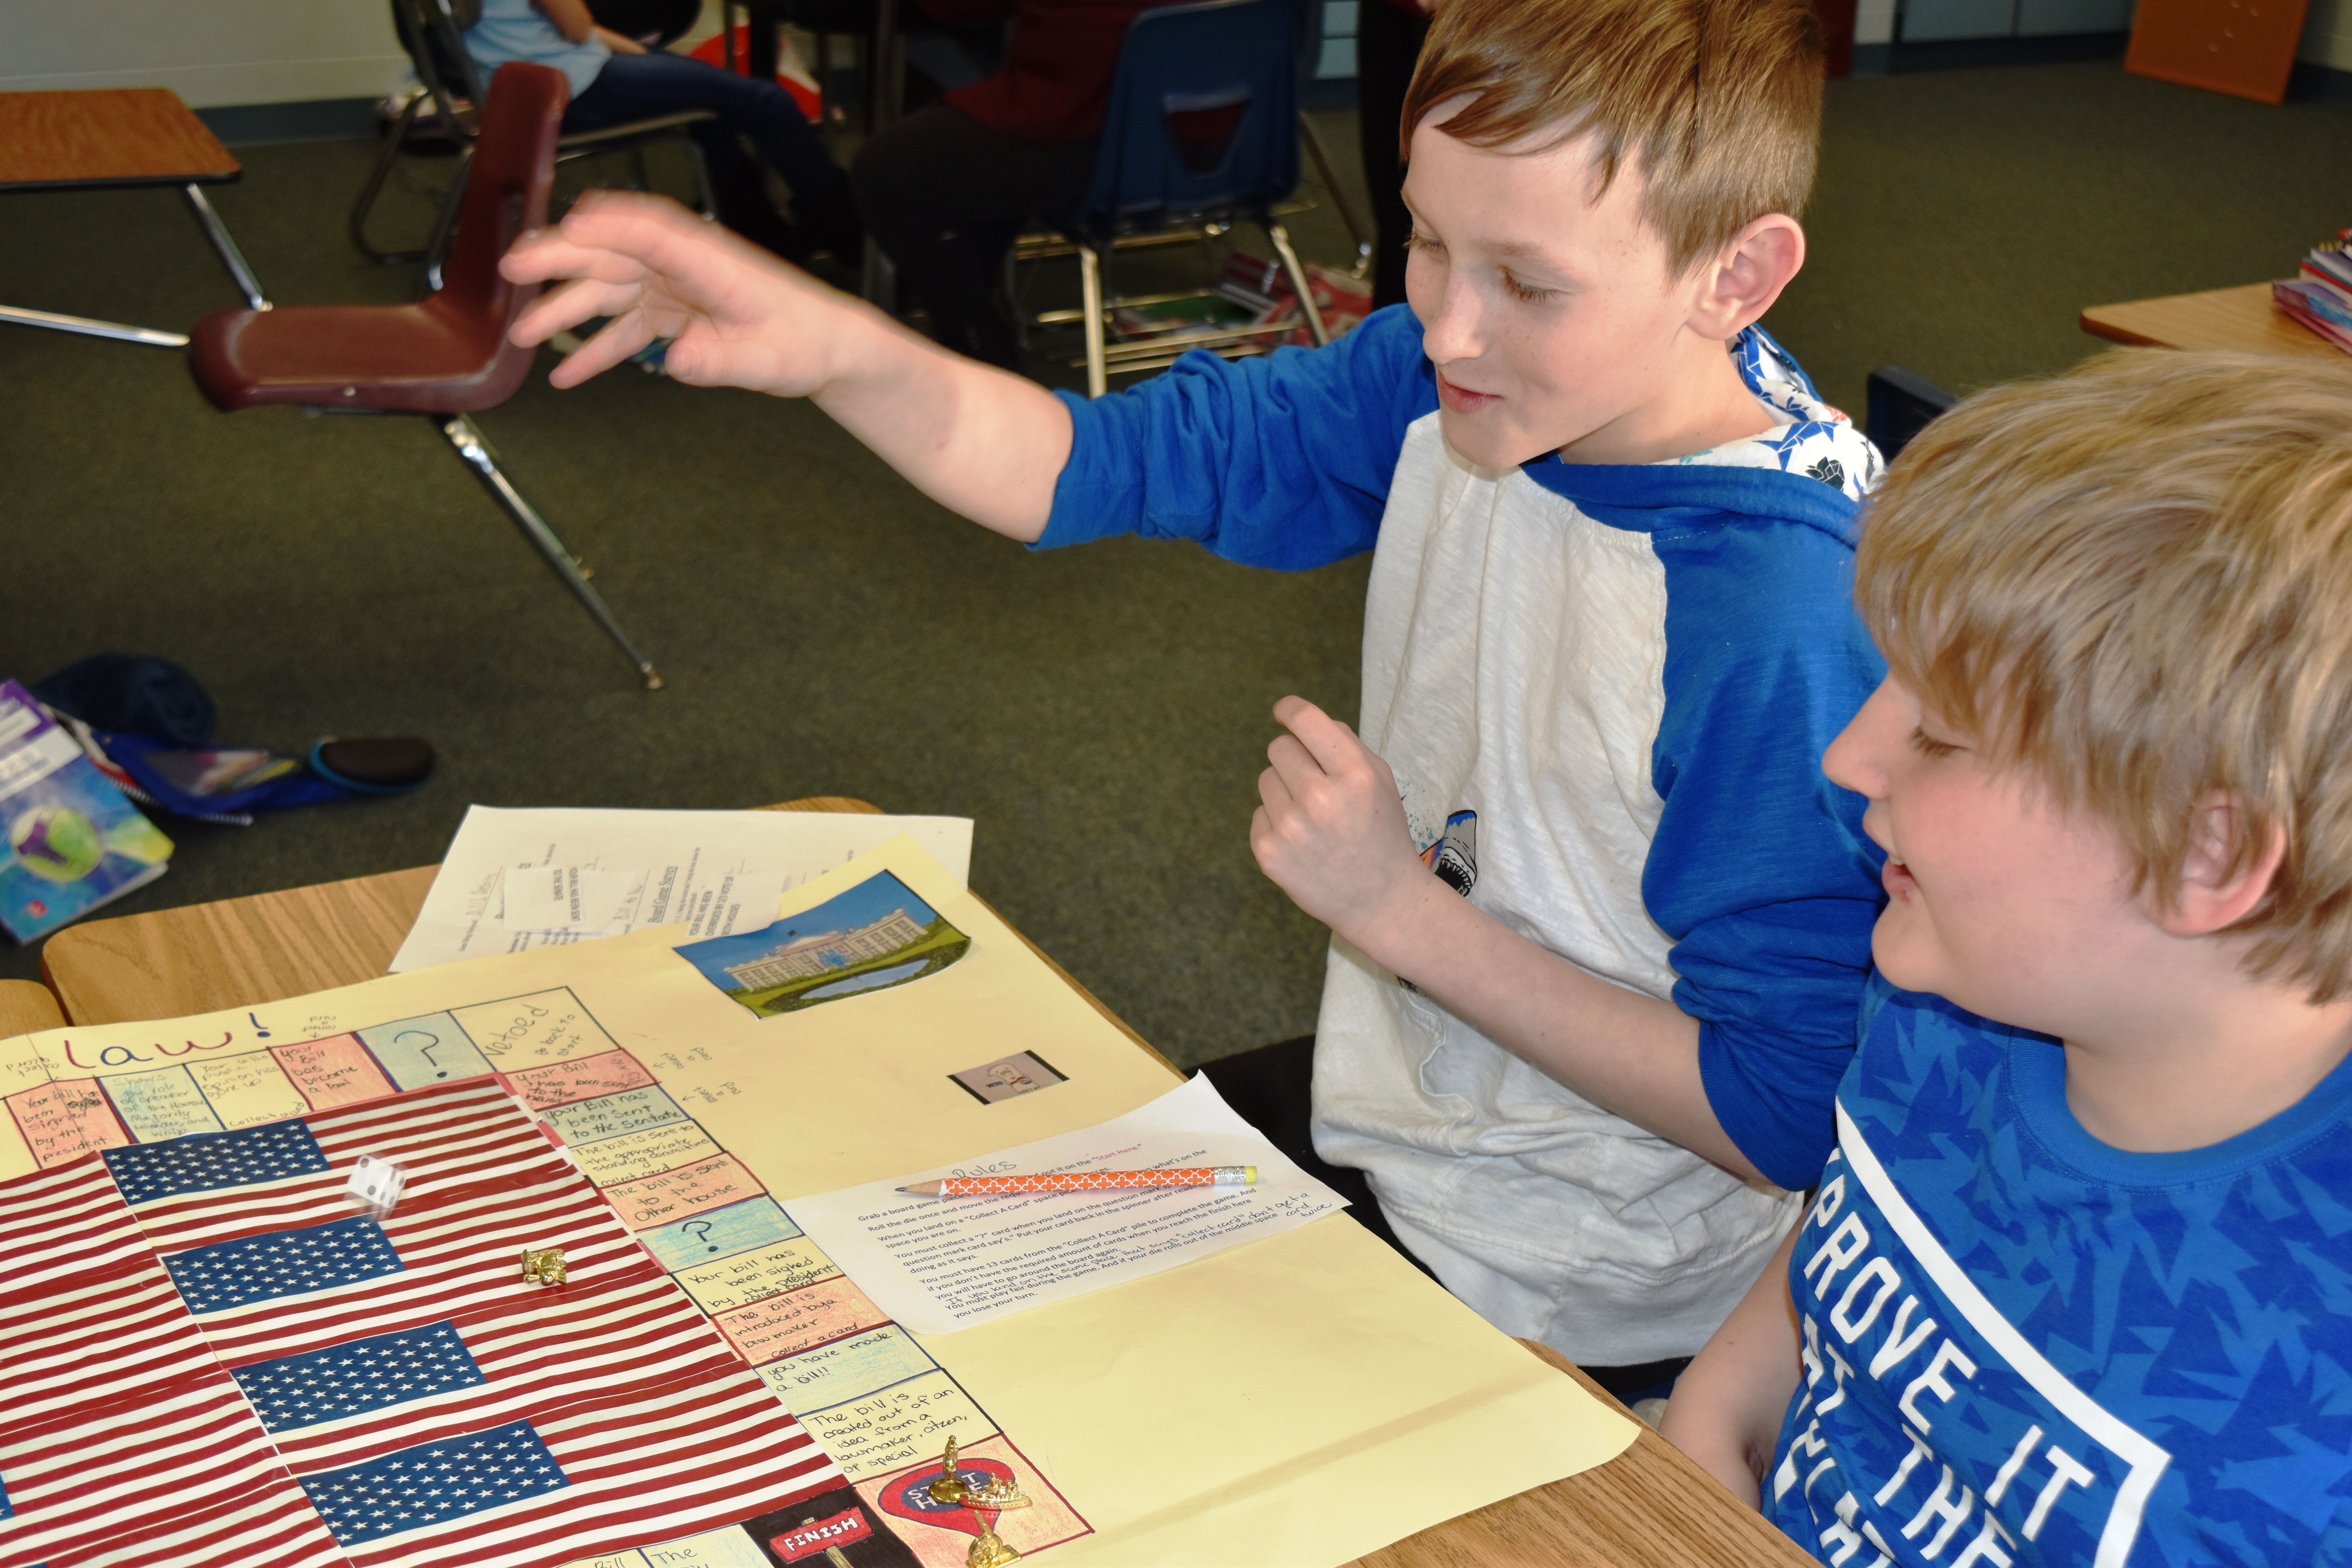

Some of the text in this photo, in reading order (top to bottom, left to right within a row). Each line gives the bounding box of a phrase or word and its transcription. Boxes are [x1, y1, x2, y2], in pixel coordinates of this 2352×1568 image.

[394, 1031, 448, 1078] ?
[616, 1091, 648, 1103] has
[567, 1114, 608, 1127] been
[571, 1123, 617, 1138] to the
[572, 1147, 603, 1156] The
[604, 1140, 629, 1150] bill
[952, 1161, 1016, 1178] Rules
[606, 1187, 637, 1198] The
[641, 1178, 672, 1190] bill
[638, 1182, 704, 1205] to the
[682, 1184, 737, 1205] house
[858, 1213, 880, 1221] Grab
[888, 1205, 915, 1214] board
[916, 1200, 940, 1209] game
[942, 1195, 964, 1203] piece
[877, 1232, 906, 1241] When
[924, 1222, 944, 1231] land
[1034, 1193, 1058, 1204] space
[682, 1221, 719, 1252] ?
[940, 1270, 963, 1280] must
[962, 1265, 986, 1273] have
[1000, 1256, 1024, 1265] cards
[1024, 1249, 1046, 1258] from
[1159, 1206, 1198, 1221] complete
[1214, 1194, 1240, 1205] game.
[1240, 1188, 1257, 1196] And
[730, 1259, 759, 1274] bill
[766, 1250, 795, 1262] has
[910, 1264, 936, 1273] doing
[956, 1254, 979, 1262] says.
[725, 1273, 762, 1287] been
[935, 1292, 953, 1301] you
[954, 1286, 971, 1295] will
[970, 1281, 994, 1290] have
[1018, 1266, 1051, 1278] around
[1067, 1254, 1094, 1265] board
[1094, 1248, 1121, 1258] again.
[707, 1298, 736, 1308] by
[742, 1285, 771, 1296] the
[724, 1312, 759, 1323] The
[953, 1310, 972, 1319] you
[971, 1304, 992, 1312] lose
[992, 1298, 1013, 1307] your
[768, 1333, 893, 1381] you have made
[1800, 1174, 1978, 1436] PROVE
[1984, 1424, 2095, 1542] IT
[793, 1366, 830, 1384] bill!!
[808, 1393, 909, 1426] The bill is
[824, 1389, 955, 1439] created out of an
[833, 1436, 869, 1449] idea
[875, 1419, 918, 1436] from
[867, 1445, 918, 1466] special
[1874, 1423, 2017, 1568] THE
[784, 1517, 858, 1552] FINISH
[650, 1549, 698, 1564] The
